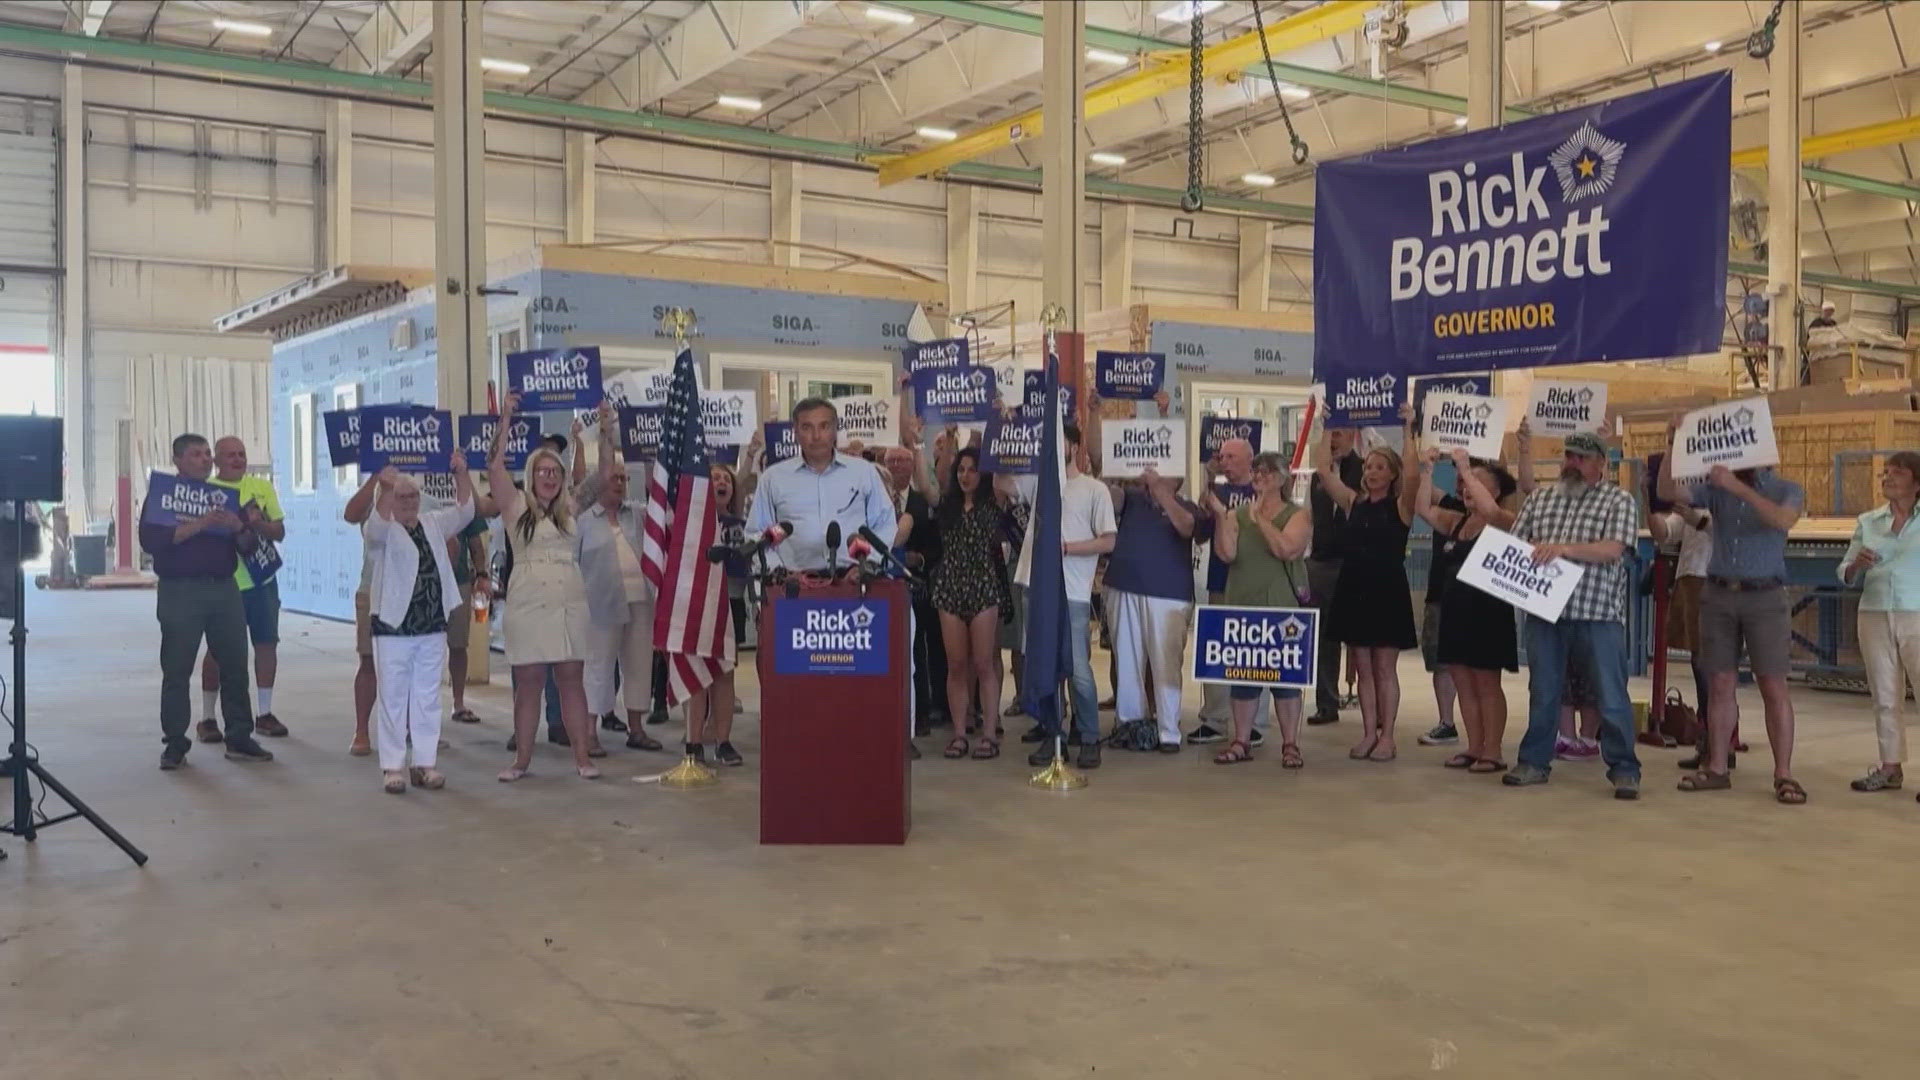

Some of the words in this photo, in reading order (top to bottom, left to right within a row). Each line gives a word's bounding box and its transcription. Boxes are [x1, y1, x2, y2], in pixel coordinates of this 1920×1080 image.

[1428, 151, 1550, 237] Rick
[1391, 205, 1611, 301] Bennett
[533, 296, 569, 313] SIGA
[772, 314, 813, 331] SIGA
[1434, 303, 1555, 338] GOVERNOR
[881, 322, 908, 338] SIG
[919, 344, 945, 361] Rick
[1175, 342, 1204, 358] SIGA
[1254, 347, 1282, 362] SIGA
[533, 357, 571, 376] Rick
[1114, 357, 1140, 373] Rick
[523, 373, 589, 391] Bennett
[652, 373, 673, 387] Ric
[937, 372, 970, 391] Rick
[1105, 369, 1153, 385] Bennett
[1346, 377, 1378, 395] Rick
[926, 387, 987, 405] Bennett
[1336, 391, 1394, 411] Bennett
[1547, 387, 1576, 404] Rick
[845, 401, 872, 417] Rick
[1440, 401, 1473, 421] Rick
[1535, 402, 1590, 421] Bennett
[384, 416, 421, 436] Rick
[635, 413, 663, 430] Rick
[703, 411, 743, 427] nnett
[1430, 416, 1486, 438] Bennett
[1546, 421, 1576, 430] GOVERNOR
[1697, 413, 1735, 437] Rick
[629, 428, 661, 446] Benn
[1001, 424, 1031, 441] Rick
[1123, 427, 1155, 444] Rick
[1213, 423, 1237, 440] Rick
[372, 432, 440, 453] Bennett
[471, 435, 529, 453] Beett
[990, 438, 1042, 456] Bennet
[1113, 441, 1171, 459] Bennett
[1439, 436, 1469, 446] GOVERNOR
[1686, 428, 1758, 454] Bennett
[1702, 451, 1743, 464] GOVERNOR
[424, 472, 453, 486] Rick
[174, 483, 209, 504] Rick
[161, 494, 214, 515] Benn
[1501, 544, 1540, 575] Rick
[1481, 552, 1553, 597] Bennett
[1491, 578, 1529, 599] GOVERNOR
[806, 609, 850, 631] Rick
[792, 628, 872, 650] Bennett
[1223, 617, 1277, 645] Rick
[810, 654, 854, 663] GOVERNOR
[1205, 640, 1303, 670] Bennett
[1225, 668, 1281, 682] GOVERNOR
